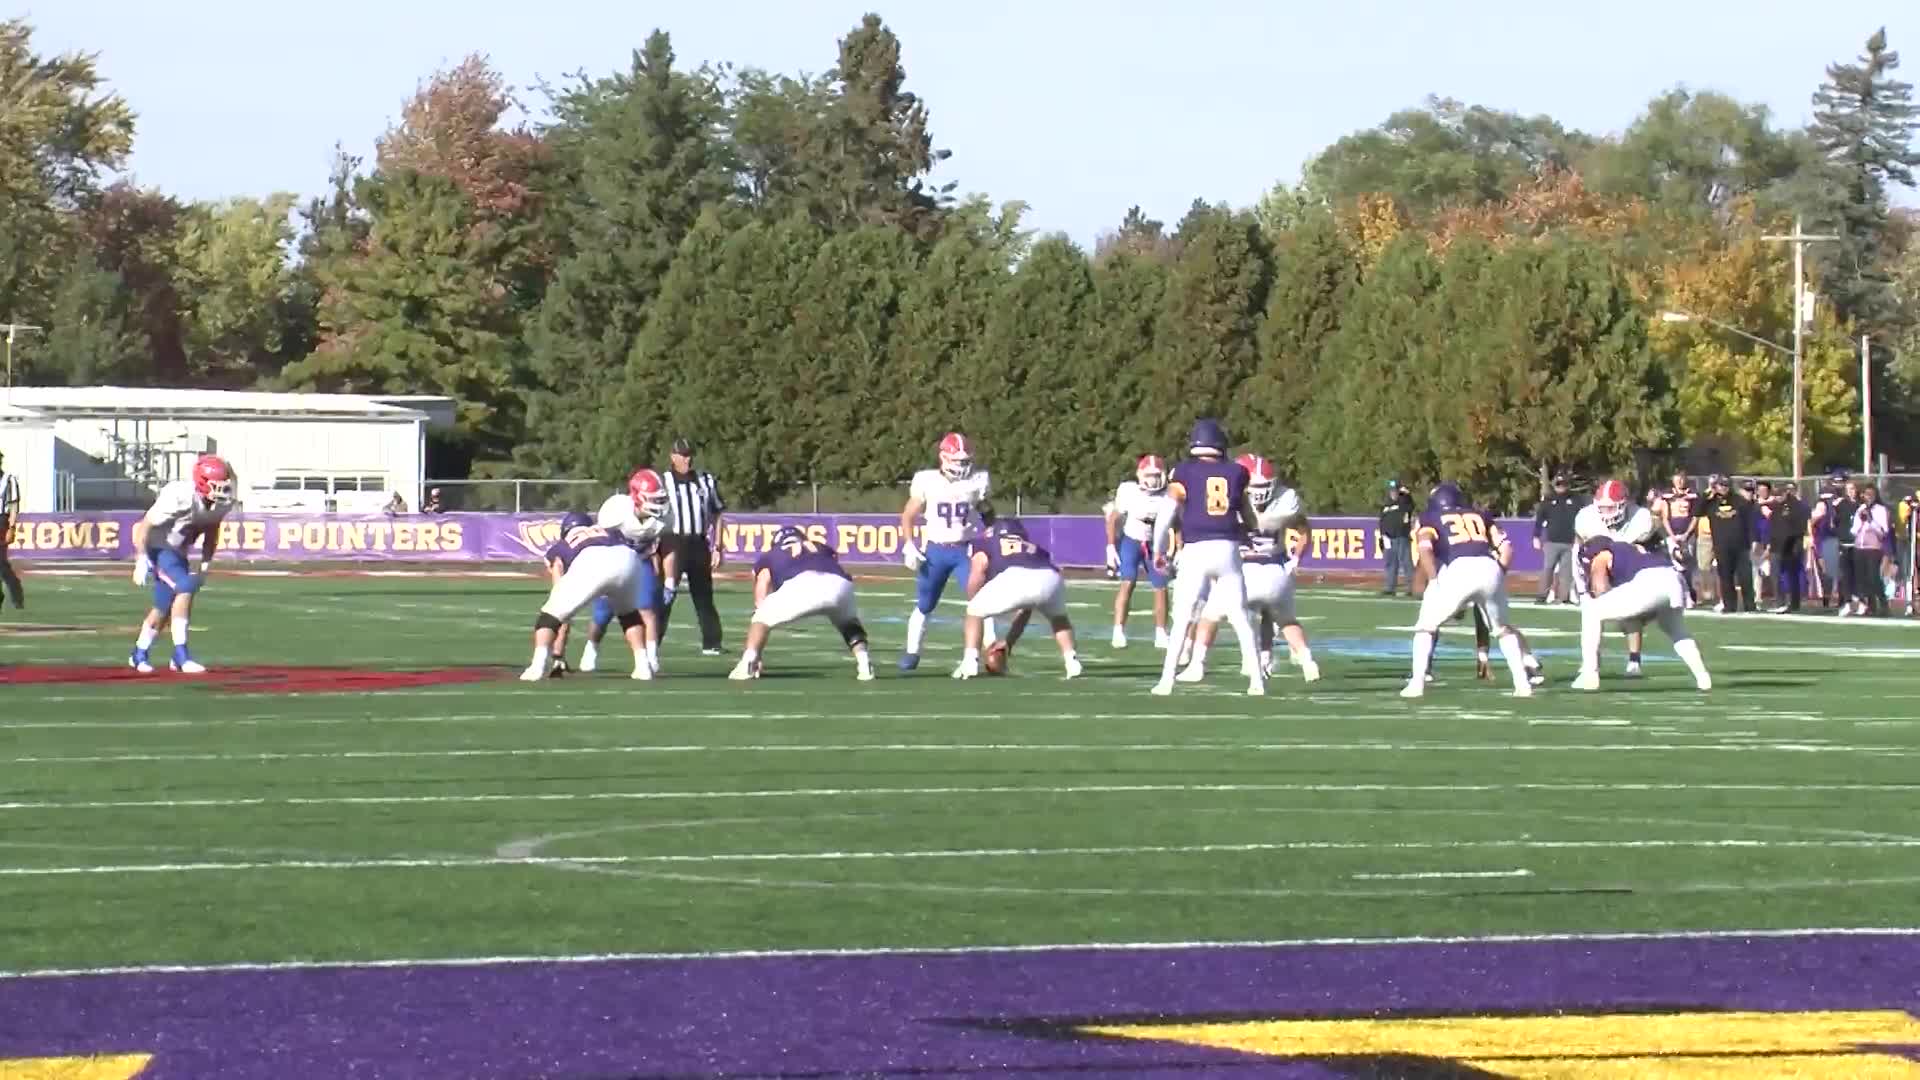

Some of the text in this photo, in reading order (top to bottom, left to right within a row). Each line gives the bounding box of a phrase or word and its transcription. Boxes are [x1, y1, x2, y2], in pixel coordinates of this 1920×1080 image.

[1206, 476, 1229, 516] 8
[937, 503, 969, 528] 99
[1440, 513, 1489, 545] 30
[9, 521, 120, 550] HOME
[214, 521, 266, 550] HE
[278, 521, 464, 551] POINTERS
[1311, 529, 1365, 560] THE
